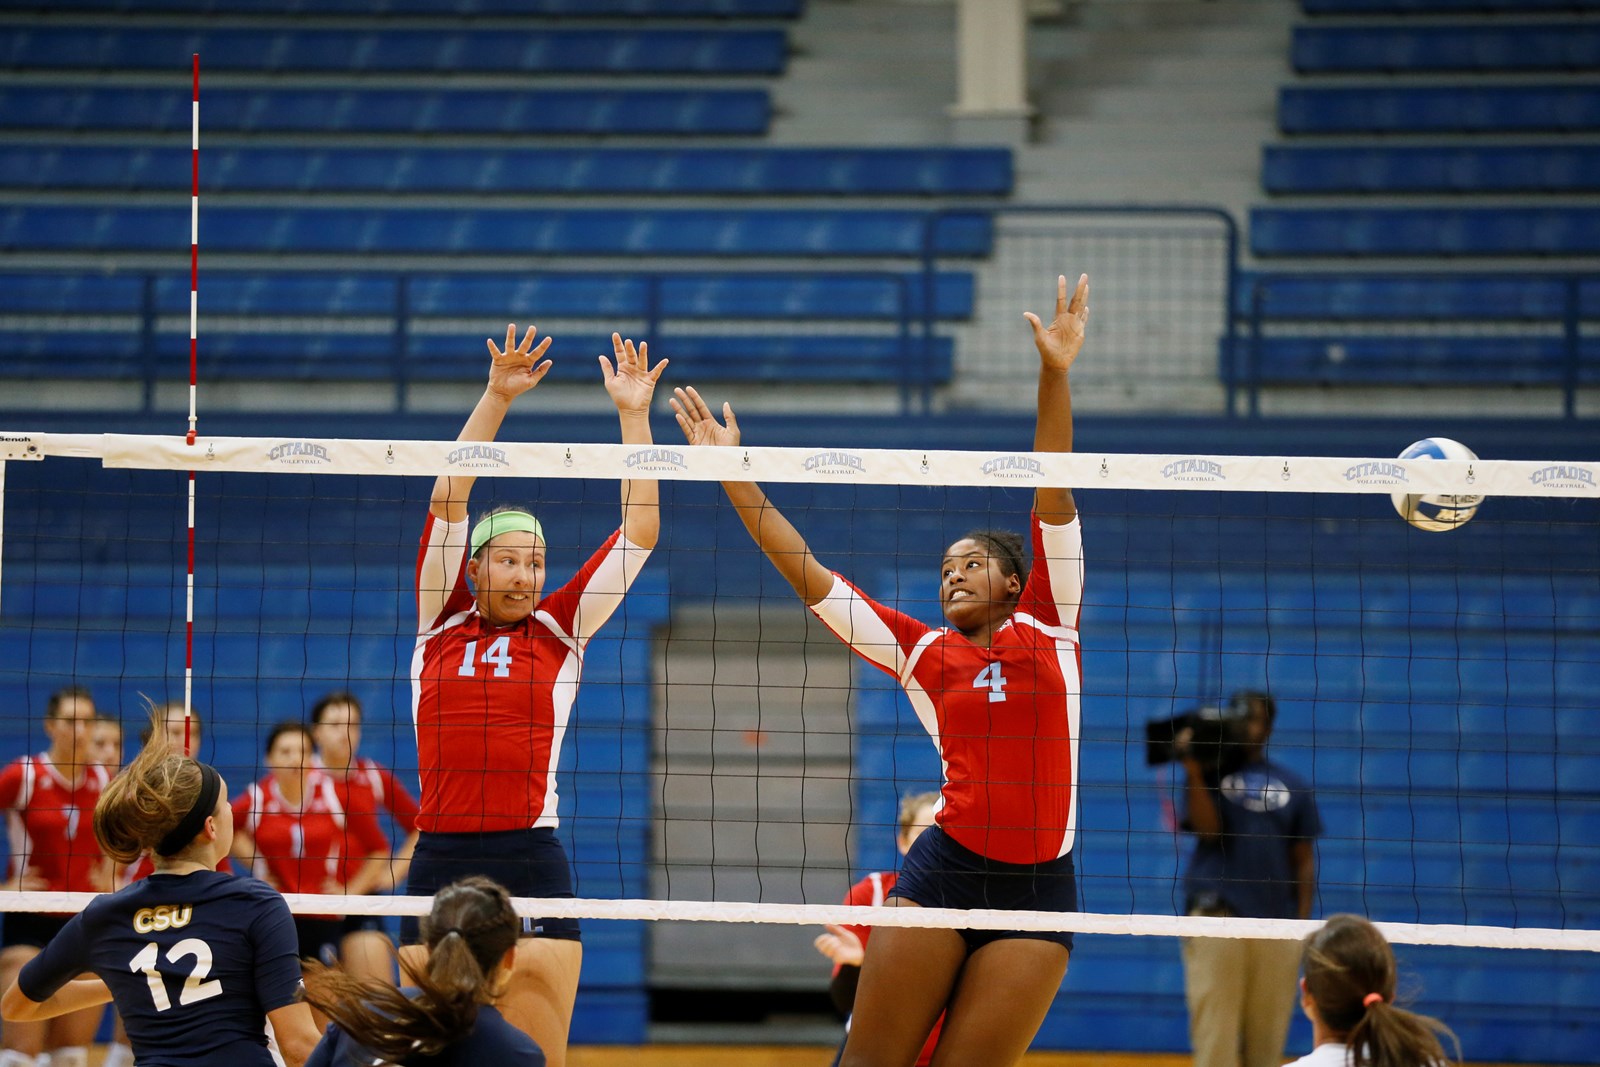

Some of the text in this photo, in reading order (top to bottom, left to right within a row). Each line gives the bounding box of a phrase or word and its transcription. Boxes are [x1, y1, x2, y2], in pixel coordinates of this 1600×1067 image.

[267, 441, 332, 462] CITADEL
[445, 445, 510, 466] CITADEL
[622, 448, 688, 470] CITADEL
[801, 451, 867, 473] CITADEL
[979, 455, 1045, 477] CITADEL
[1159, 458, 1226, 480] CITADEL
[1341, 462, 1410, 483] CITADEL
[1528, 465, 1598, 487] CITADEL
[457, 636, 512, 678] 14
[972, 661, 1008, 703] 4
[133, 904, 193, 934] CSU
[128, 938, 223, 1012] 12
